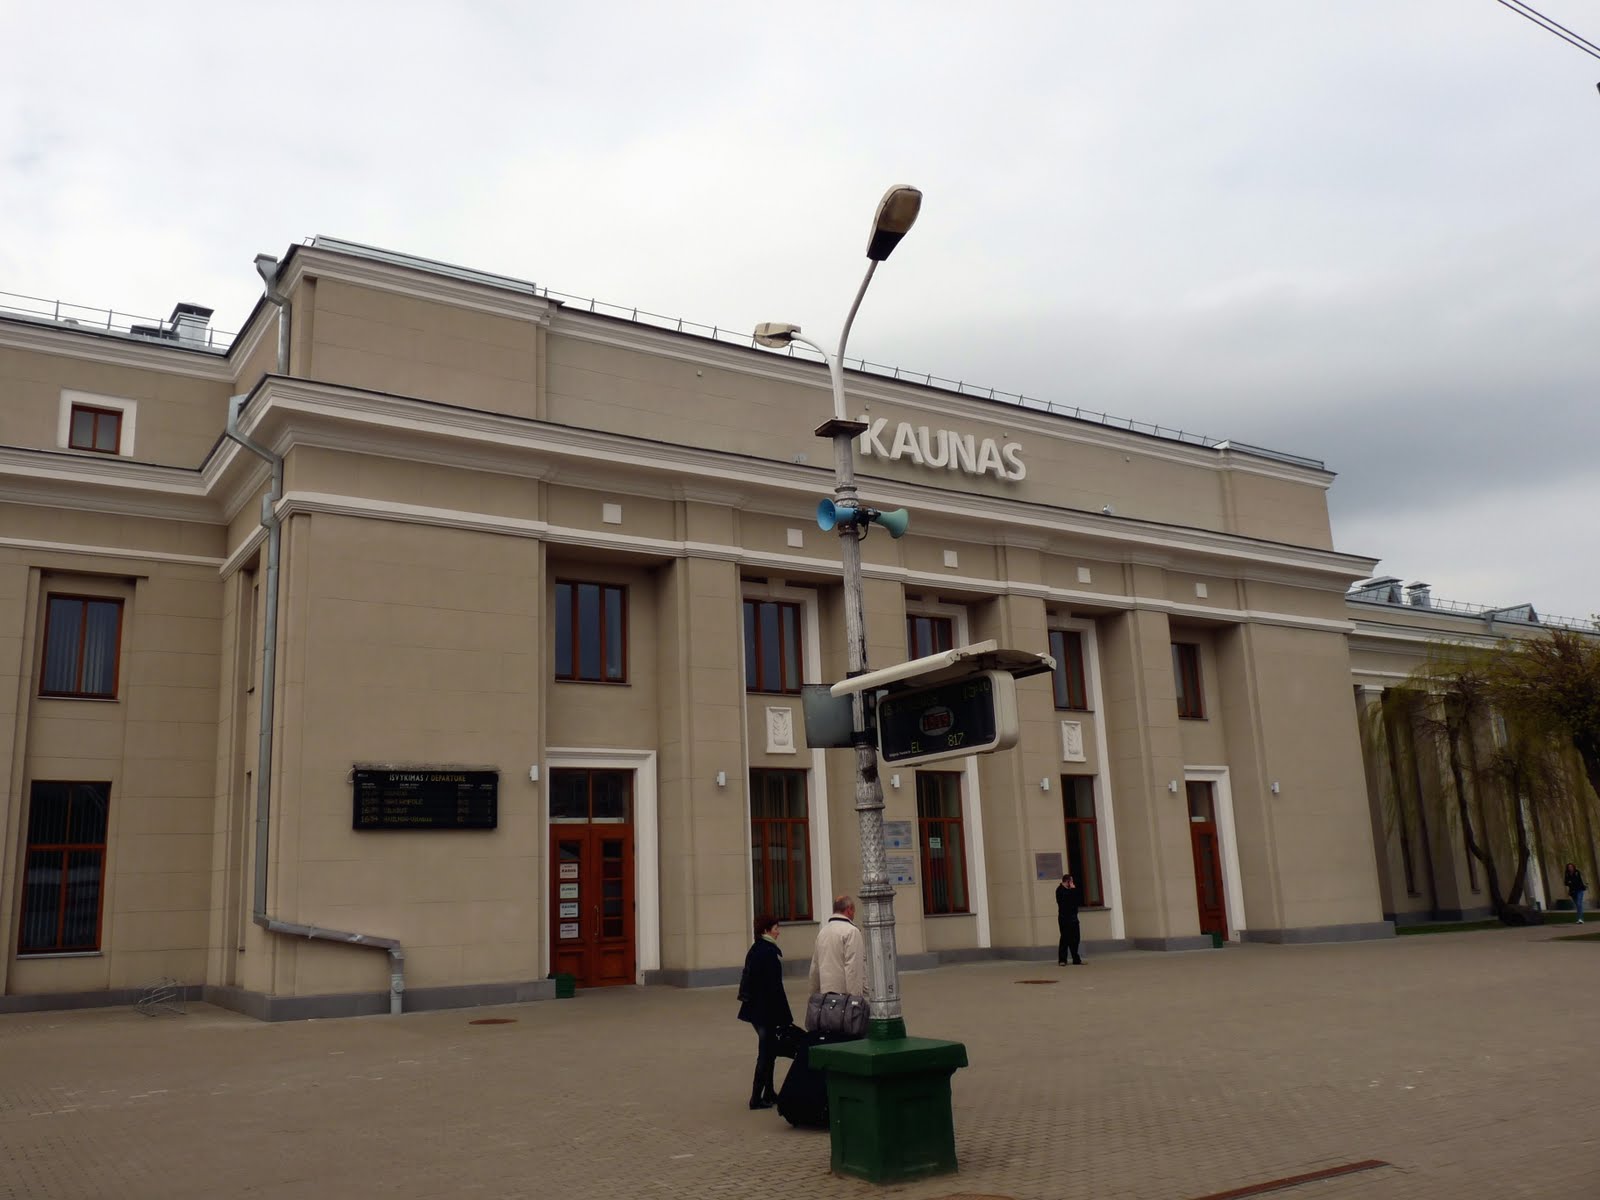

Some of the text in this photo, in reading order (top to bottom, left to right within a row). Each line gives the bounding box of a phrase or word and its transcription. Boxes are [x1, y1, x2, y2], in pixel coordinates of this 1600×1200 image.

[857, 414, 1026, 481] KAUNAS
[947, 732, 964, 747] 817
[431, 774, 467, 783] DEPARTURE
